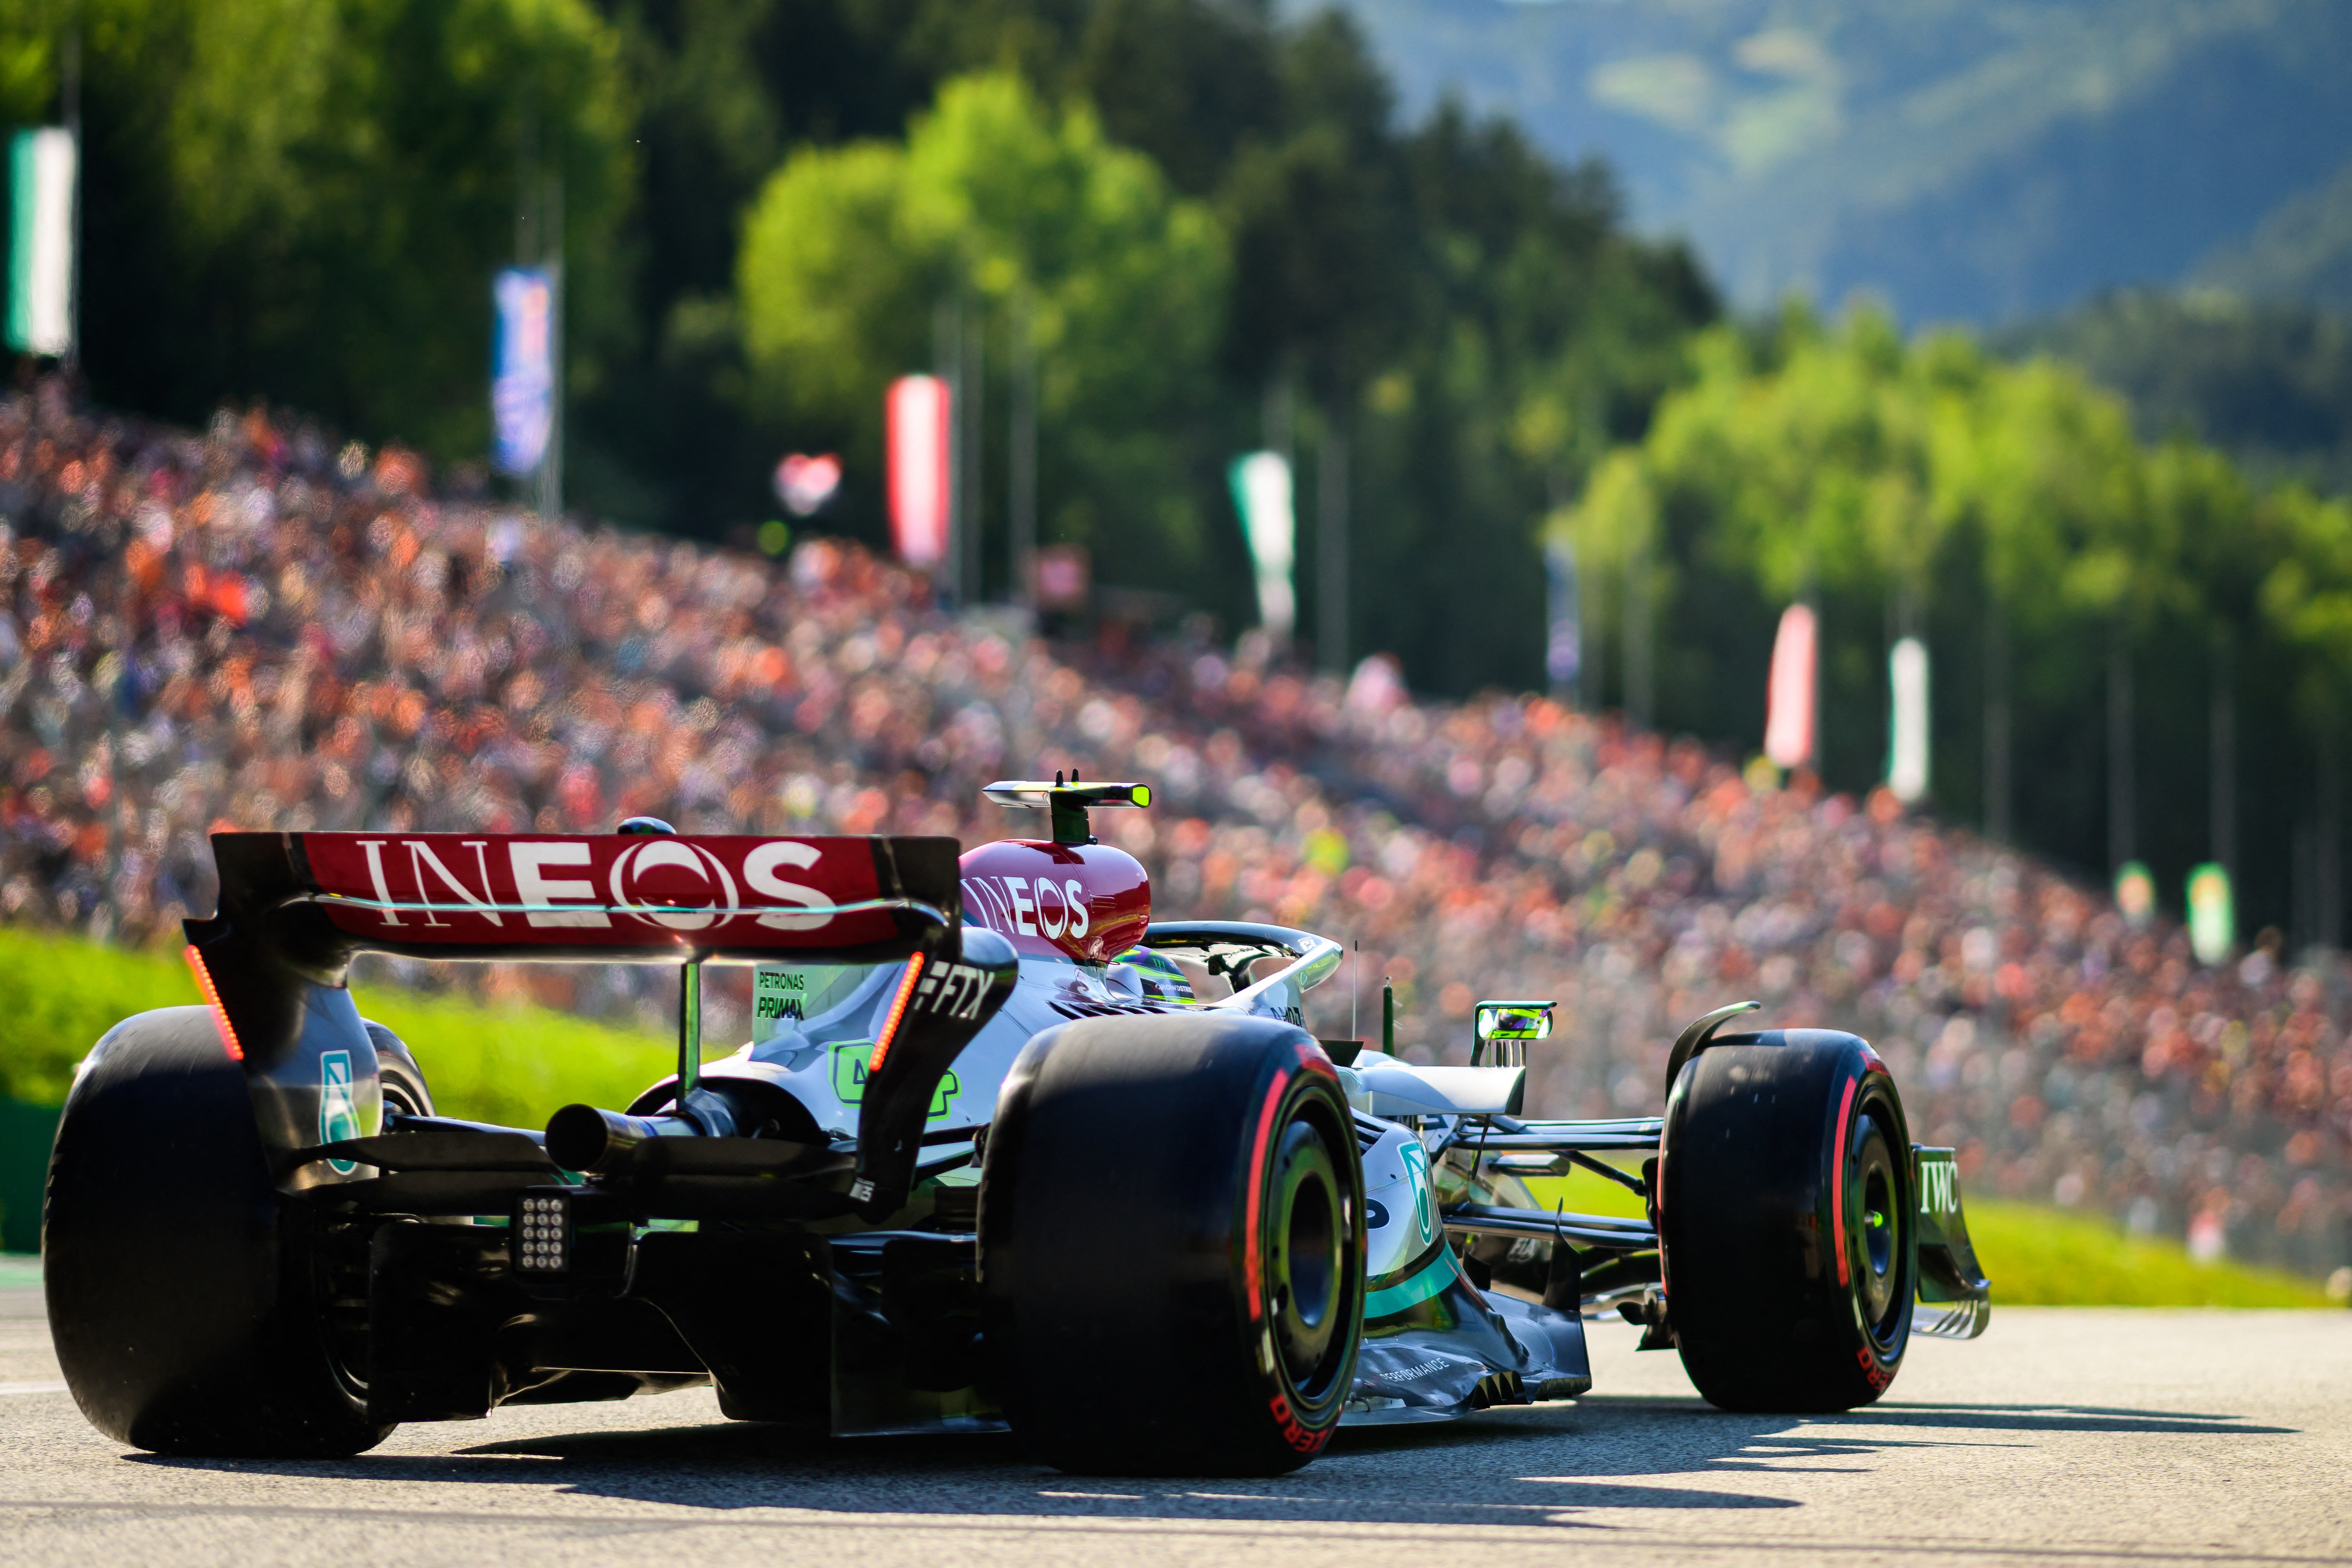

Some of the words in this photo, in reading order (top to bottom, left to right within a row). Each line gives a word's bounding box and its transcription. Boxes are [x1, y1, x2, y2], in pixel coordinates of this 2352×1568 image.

[356, 840, 837, 930] INEOS
[959, 876, 1089, 939] INEOS
[758, 993, 808, 1021] PRIMAX
[760, 971, 804, 991] PETRONAS
[931, 963, 995, 1020] FTX
[1920, 1160, 1958, 1214] IWC
[1379, 1357, 1450, 1382] PERFORMANCE
